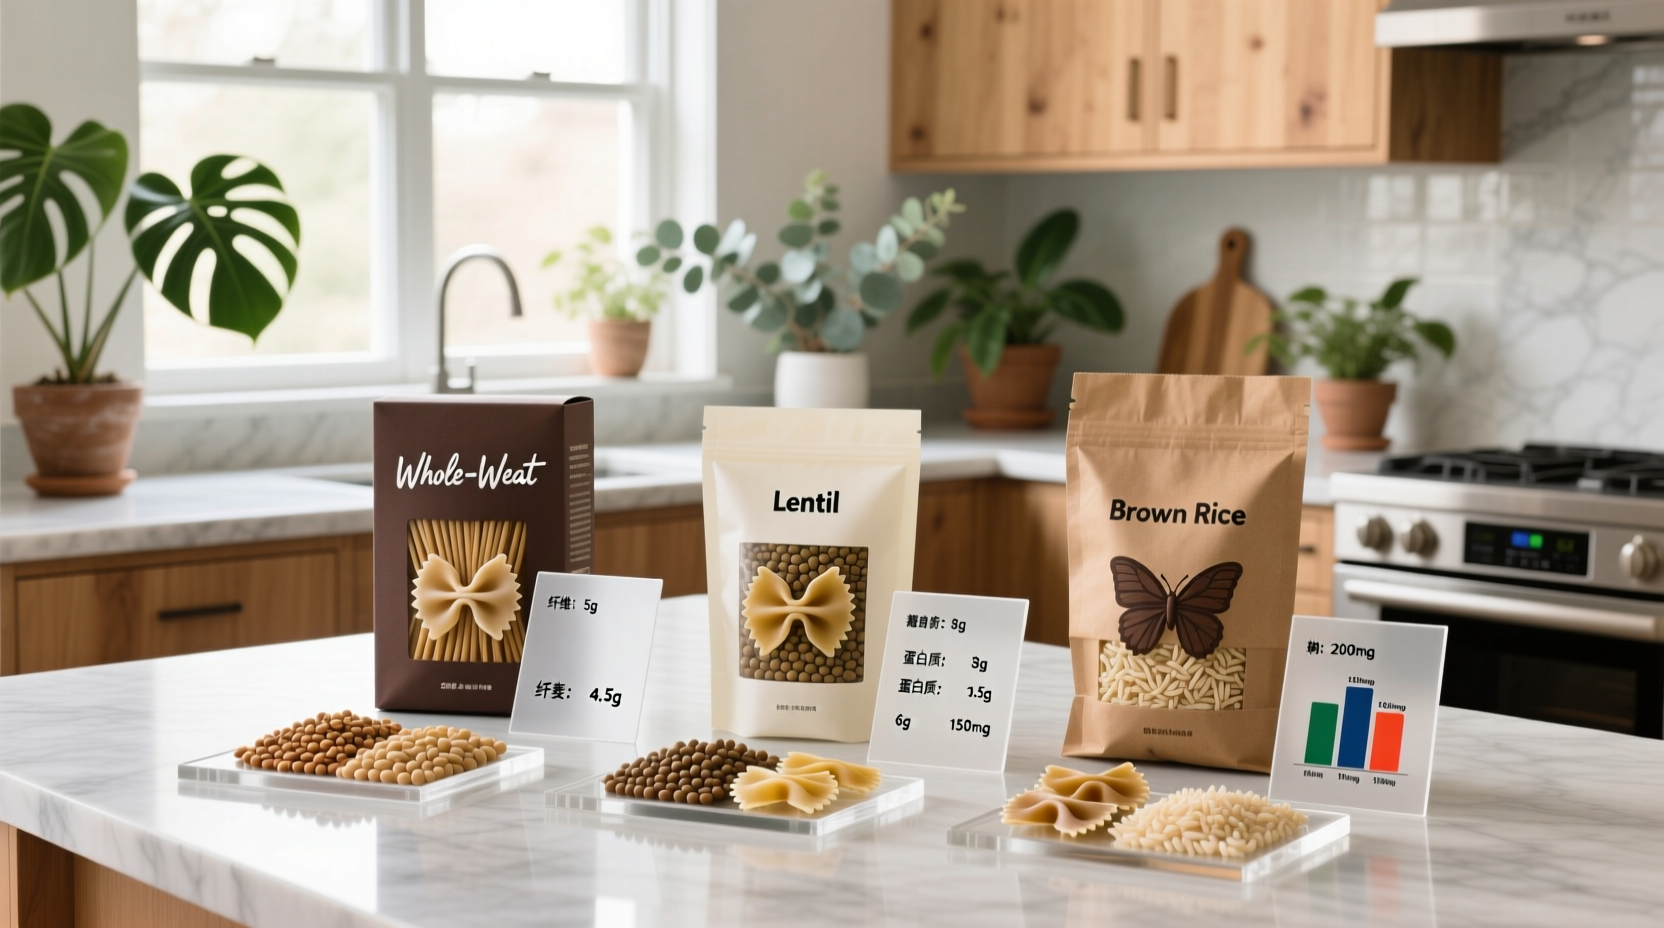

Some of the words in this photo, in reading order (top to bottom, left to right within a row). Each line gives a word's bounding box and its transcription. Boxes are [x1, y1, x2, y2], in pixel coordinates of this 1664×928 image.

[396, 451, 547, 490] Whole-Weat
[773, 490, 840, 513] Lentil
[1109, 499, 1187, 524] Brown
[1193, 502, 1246, 526] Rice
[583, 598, 598, 615] 5g
[1330, 642, 1375, 661] 200mg
[589, 687, 622, 707] 4.5g
[895, 713, 911, 730] 6g
[950, 718, 991, 737] 150mg
